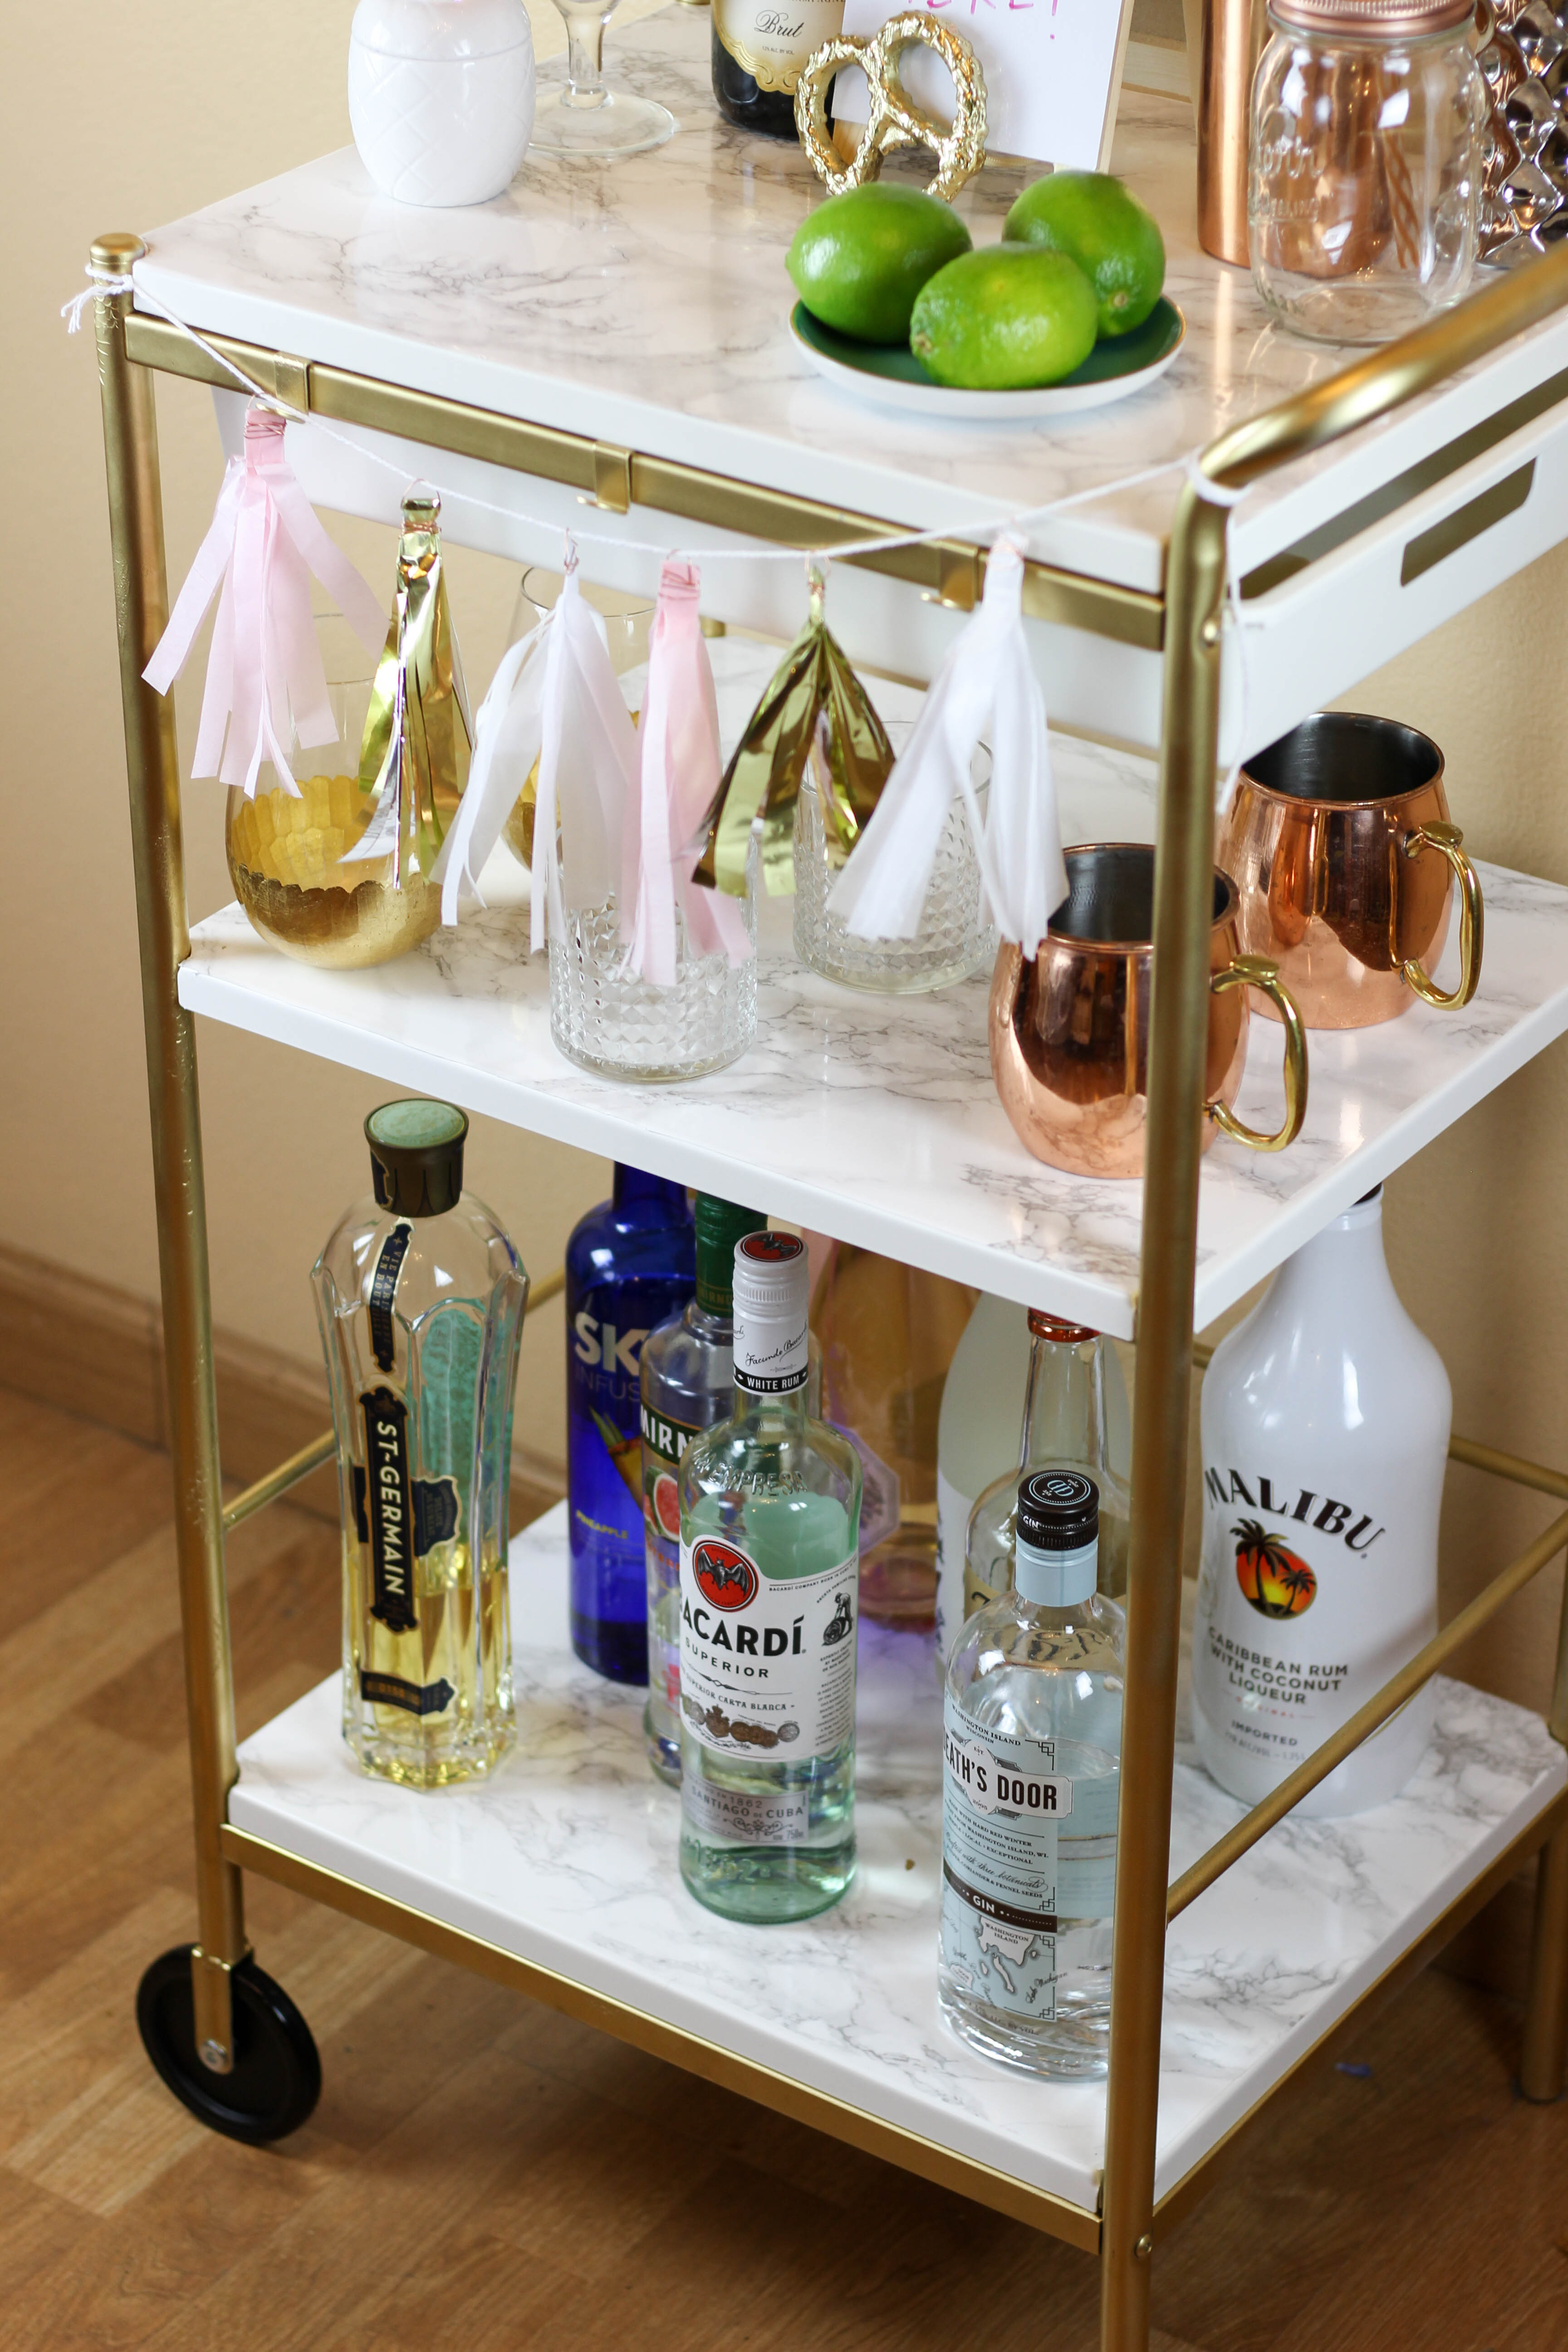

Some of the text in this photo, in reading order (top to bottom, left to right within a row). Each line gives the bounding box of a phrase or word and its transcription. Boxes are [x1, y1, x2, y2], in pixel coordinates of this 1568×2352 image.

[754, 10, 804, 37] Brut
[745, 1348, 782, 1367] Facundo
[747, 1375, 799, 1390] WHITE RUM
[1023, 1515, 1039, 1529] GIN
[1205, 1467, 1385, 1550] MALIBU
[576, 1510, 628, 1539] PINEAPPLE
[795, 1581, 818, 1589] COMPANY
[682, 1597, 804, 1656] ACARDÍ
[686, 1637, 768, 1678] SUPERIOR
[1208, 1626, 1348, 1676] CARIBBEAN RUM
[1211, 1643, 1341, 1691] WITH COCONUT
[1230, 1671, 1306, 1704] LIQUEUR
[718, 1695, 747, 1709] CARTA
[750, 1703, 787, 1711] BLANCA
[952, 1704, 1021, 1746] WASHINGTON ISLAND
[966, 1725, 994, 1744] WISCONSIN
[1232, 1720, 1298, 1747] IMPORTED
[945, 1729, 1056, 1810] EATH'S DOOR
[692, 1786, 749, 1815] SANTIAGO
[766, 1807, 803, 1818] CUBA
[730, 1796, 762, 1808] 1862
[960, 1810, 971, 1823] WITH
[973, 1820, 989, 1833] HARD
[990, 1829, 1003, 1838] RED
[1004, 1835, 1032, 1847] WINTER
[968, 1826, 1006, 1849] WASHINGTON
[1008, 1846, 1035, 1857] ISLAND,
[965, 1833, 981, 1847] LOCAL
[987, 1846, 1033, 1865] EXCEPTIONAL
[995, 1882, 1020, 1894] FENNEL
[1022, 1890, 1043, 1898] SEEDS
[973, 1896, 995, 1914] GIN
[985, 1922, 1029, 1942] WASHINGTON
[994, 1933, 1019, 1945] ISLAND
